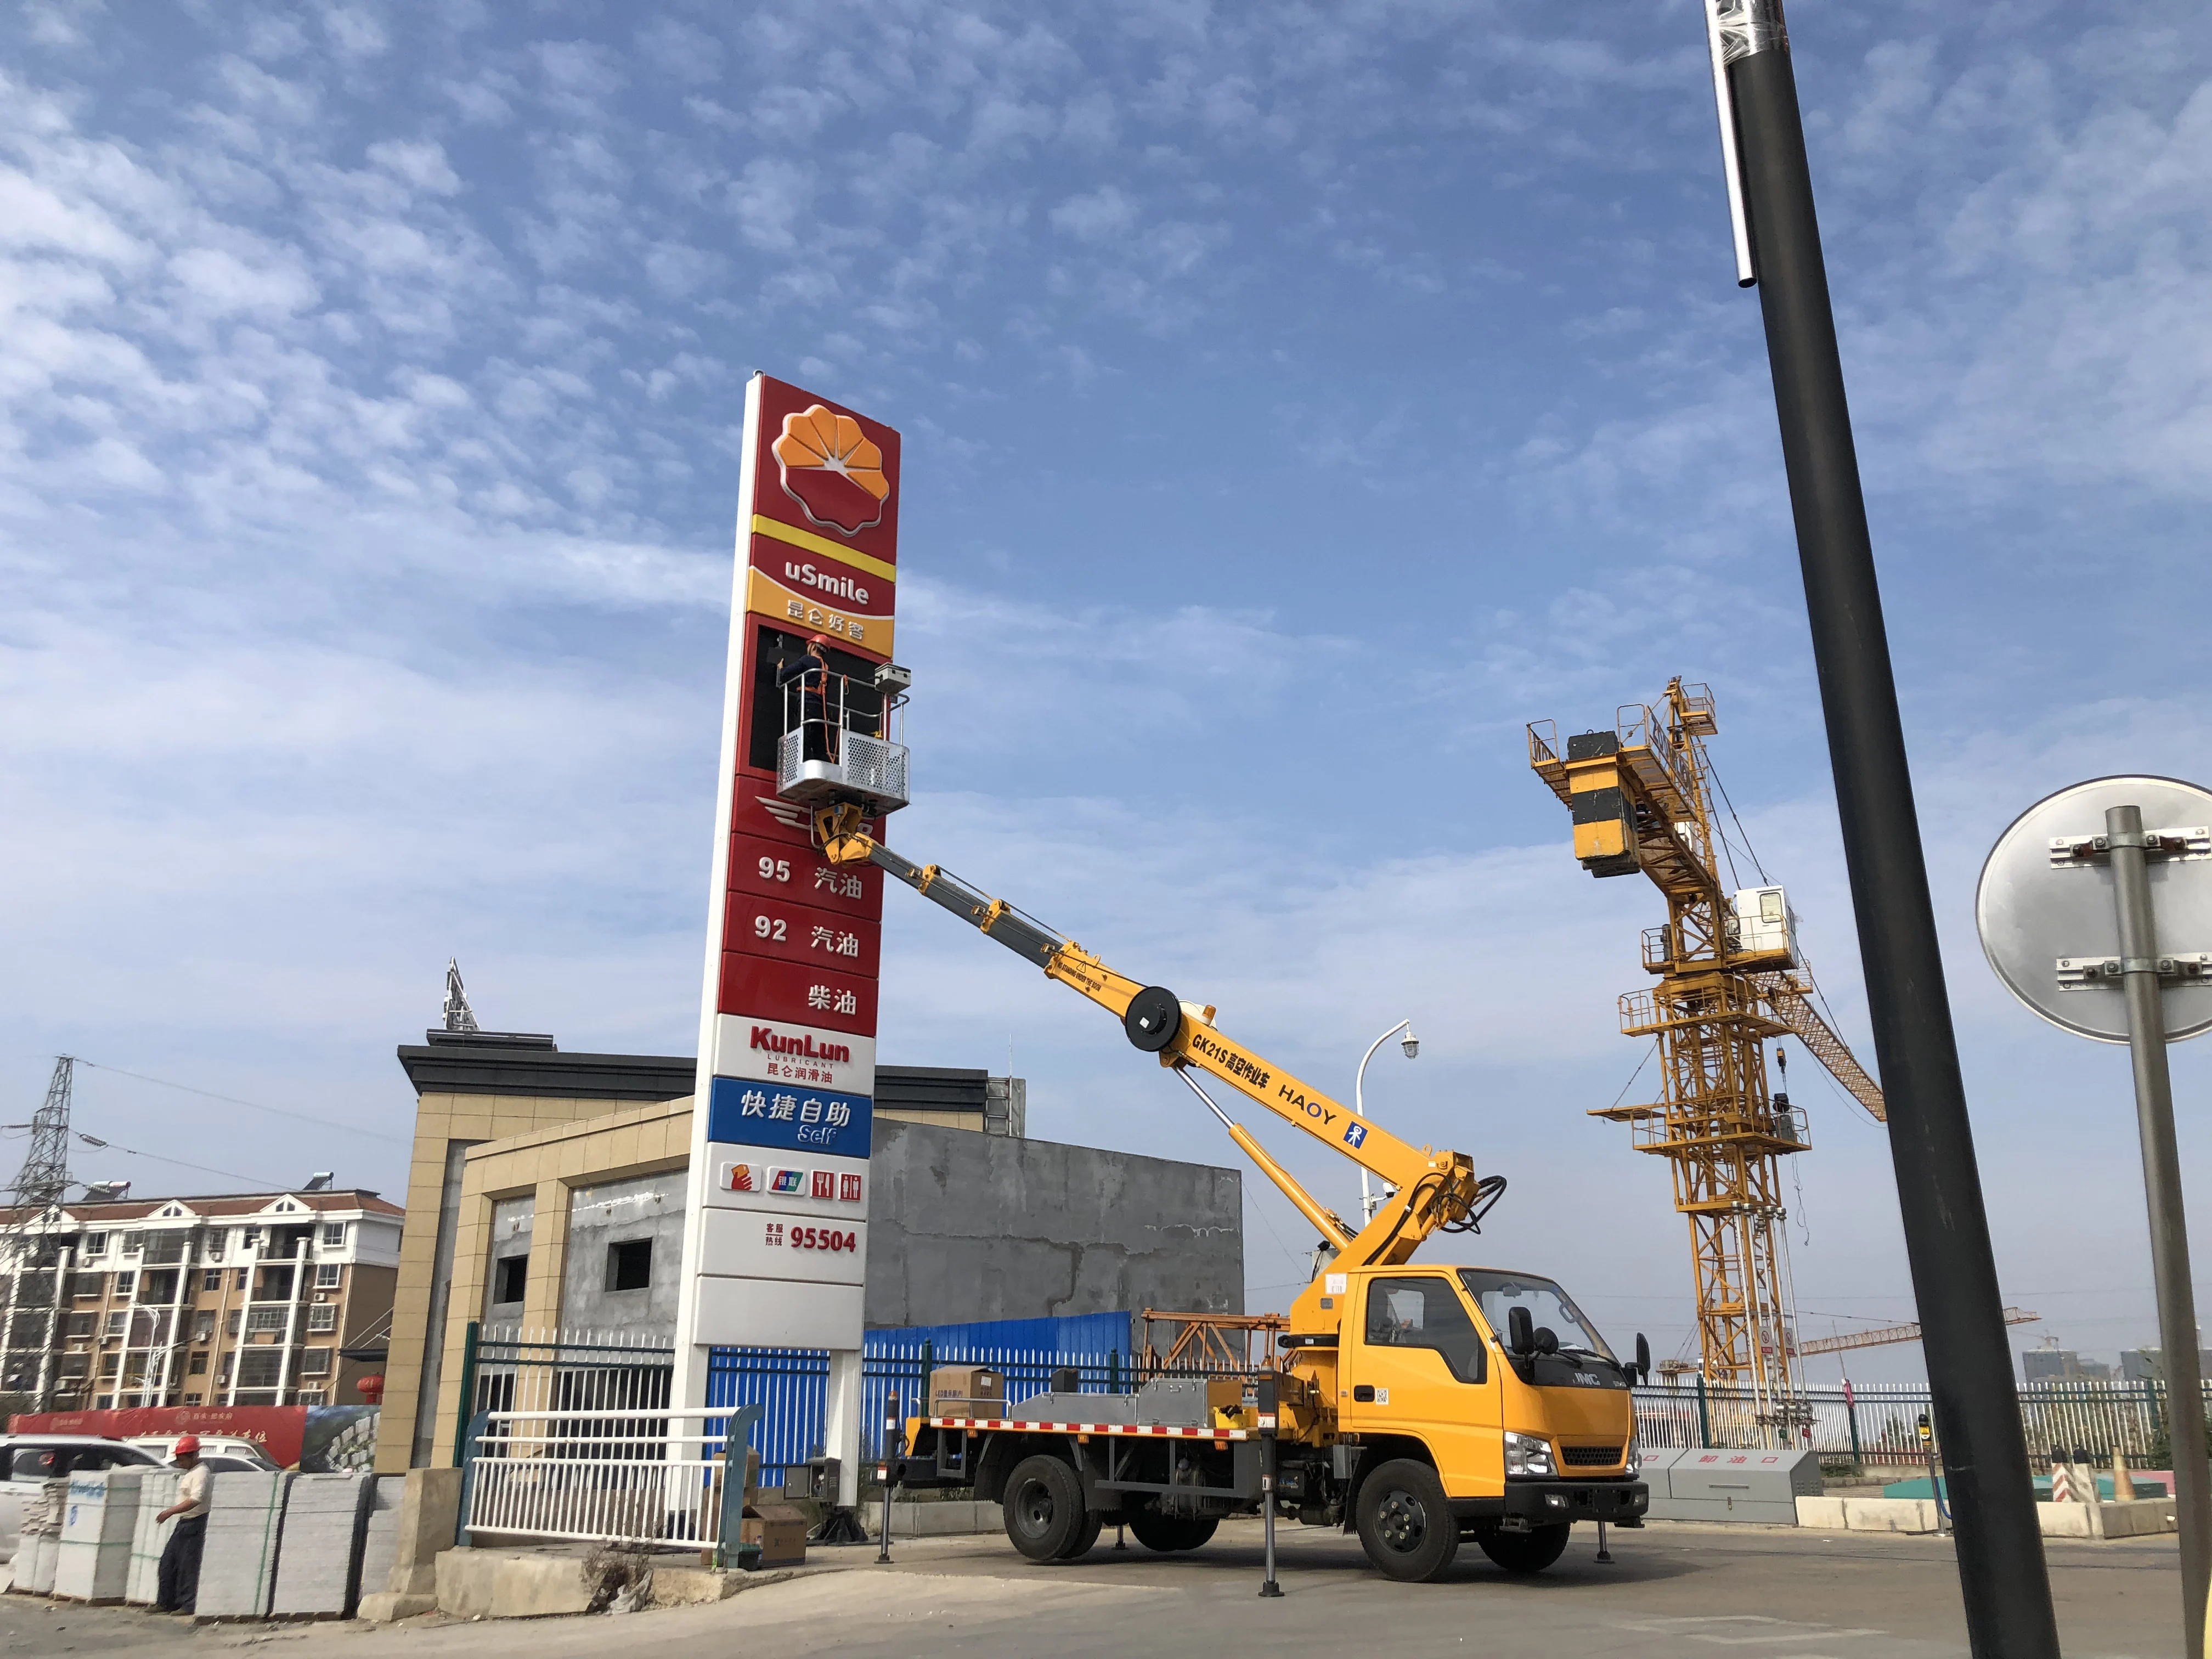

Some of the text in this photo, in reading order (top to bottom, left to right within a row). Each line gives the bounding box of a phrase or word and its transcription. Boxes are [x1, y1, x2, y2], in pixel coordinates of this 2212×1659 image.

[786, 562, 869, 605] uSmile
[788, 600, 864, 639] 昆仑好客
[759, 856, 862, 899] 95 汽油
[755, 916, 859, 958] 92 汽油
[808, 985, 856, 1015] 柴油
[751, 1026, 849, 1062] KunLun
[768, 1054, 833, 1069] LUBRICANT
[768, 1063, 833, 1084] 昆仑润滑油
[741, 1090, 850, 1127] 快捷自助
[1278, 1084, 1337, 1125] HAOY
[798, 1125, 837, 1145] Self
[778, 1176, 797, 1187] 银联
[765, 1236, 782, 1246] 热线
[766, 1223, 783, 1233] 客服
[791, 1226, 856, 1252] 95504
[1573, 1372, 1600, 1386] JMC
[1699, 1455, 1779, 1463] 卸油口
